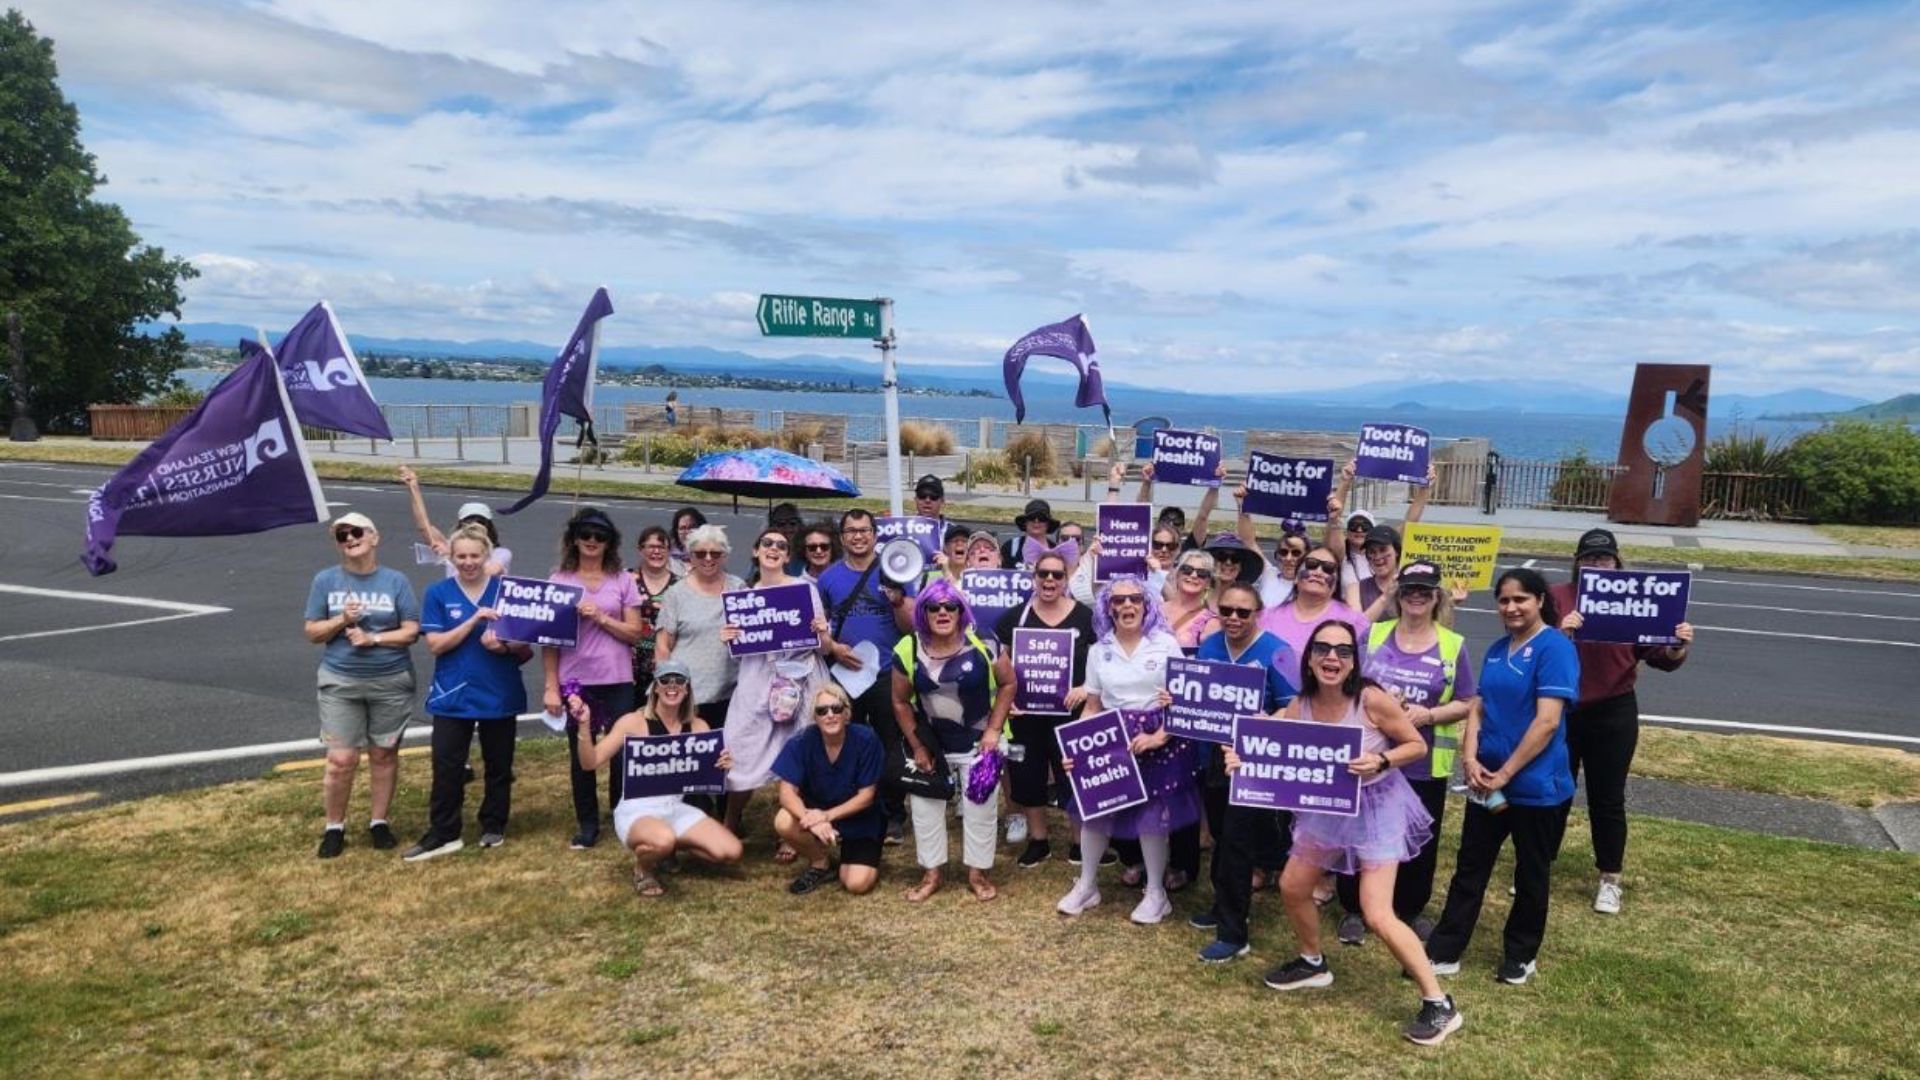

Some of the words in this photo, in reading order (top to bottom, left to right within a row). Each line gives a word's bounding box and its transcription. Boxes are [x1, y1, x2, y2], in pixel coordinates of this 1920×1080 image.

[772, 298, 807, 325] Rifle
[812, 300, 855, 334] Range
[1156, 432, 1192, 448] Toot
[1195, 436, 1218, 451] for
[1363, 426, 1402, 443] Toot
[1404, 428, 1427, 447] for
[1153, 447, 1205, 466] health
[1359, 442, 1414, 461] health
[1252, 455, 1292, 477] Toot
[1294, 461, 1327, 479] for
[1248, 473, 1307, 497] health
[906, 520, 934, 534] for
[1110, 519, 1139, 530] Here
[1101, 532, 1148, 543] because
[1444, 535, 1492, 544] STANDING
[1120, 548, 1147, 557] care
[965, 573, 1008, 589] Toot
[1012, 573, 1032, 590] fo
[1584, 573, 1638, 594] Toot
[1643, 576, 1682, 595] for
[328, 591, 396, 609] ITALIA
[503, 580, 542, 600] Toot
[544, 584, 575, 605] for
[726, 593, 766, 611] Safe
[497, 598, 555, 622] health
[1580, 594, 1659, 617] health
[728, 607, 801, 627] Staffing
[1028, 639, 1058, 650] Safe
[1017, 653, 1068, 669] staffing
[1024, 669, 1060, 679] saves
[1026, 681, 1057, 693] lives
[1168, 673, 1203, 702] Up
[1404, 685, 1429, 702] Up
[1208, 683, 1260, 711] Rise
[627, 740, 681, 757] Toot
[684, 736, 718, 755] for
[1067, 726, 1118, 755] TOOT
[1242, 735, 1281, 757] We
[1288, 744, 1351, 763] need
[628, 756, 699, 776] health
[1088, 754, 1112, 769] for
[1080, 764, 1130, 790] health
[1240, 761, 1334, 785] nurses!
